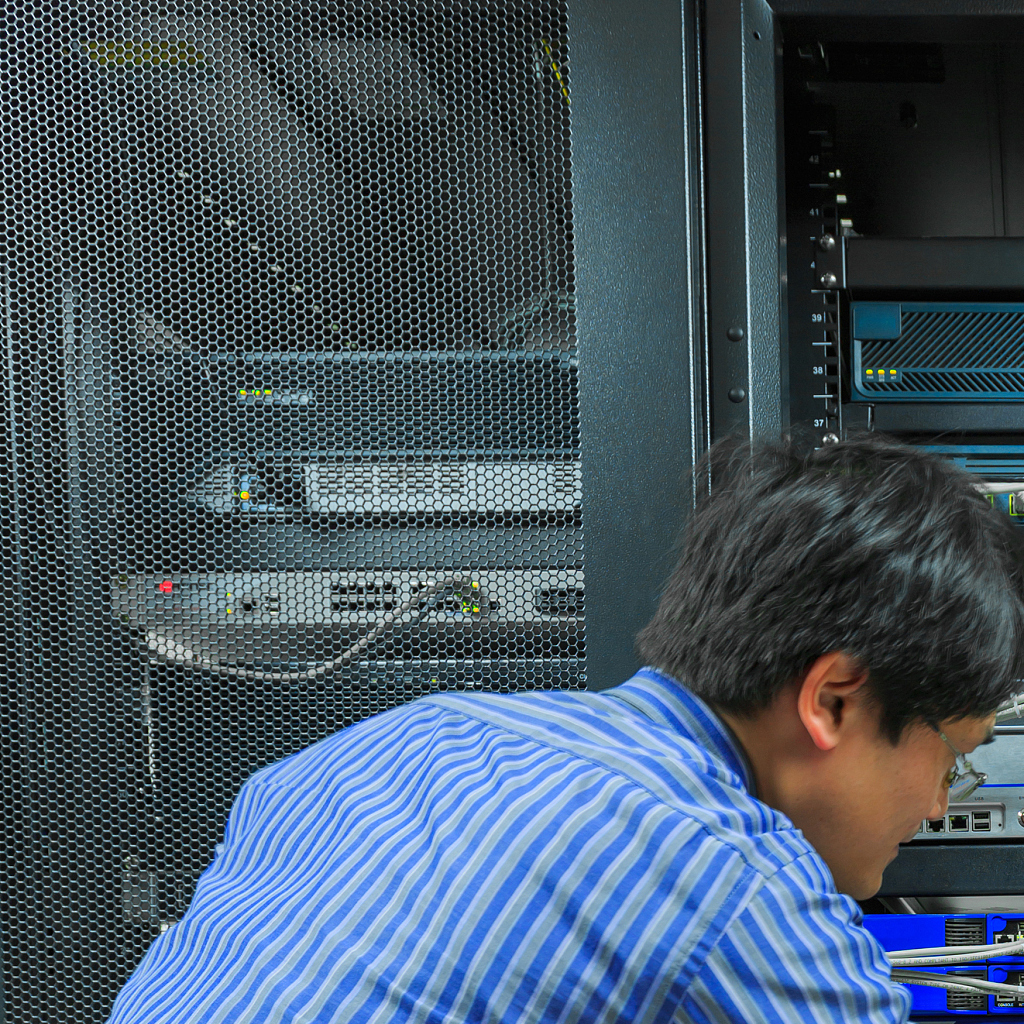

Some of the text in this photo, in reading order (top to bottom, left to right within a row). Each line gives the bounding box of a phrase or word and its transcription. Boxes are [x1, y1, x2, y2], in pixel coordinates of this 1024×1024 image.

[809, 208, 819, 216] 41
[811, 313, 823, 323] 39
[812, 366, 824, 375] 38
[813, 418, 825, 428] 37
